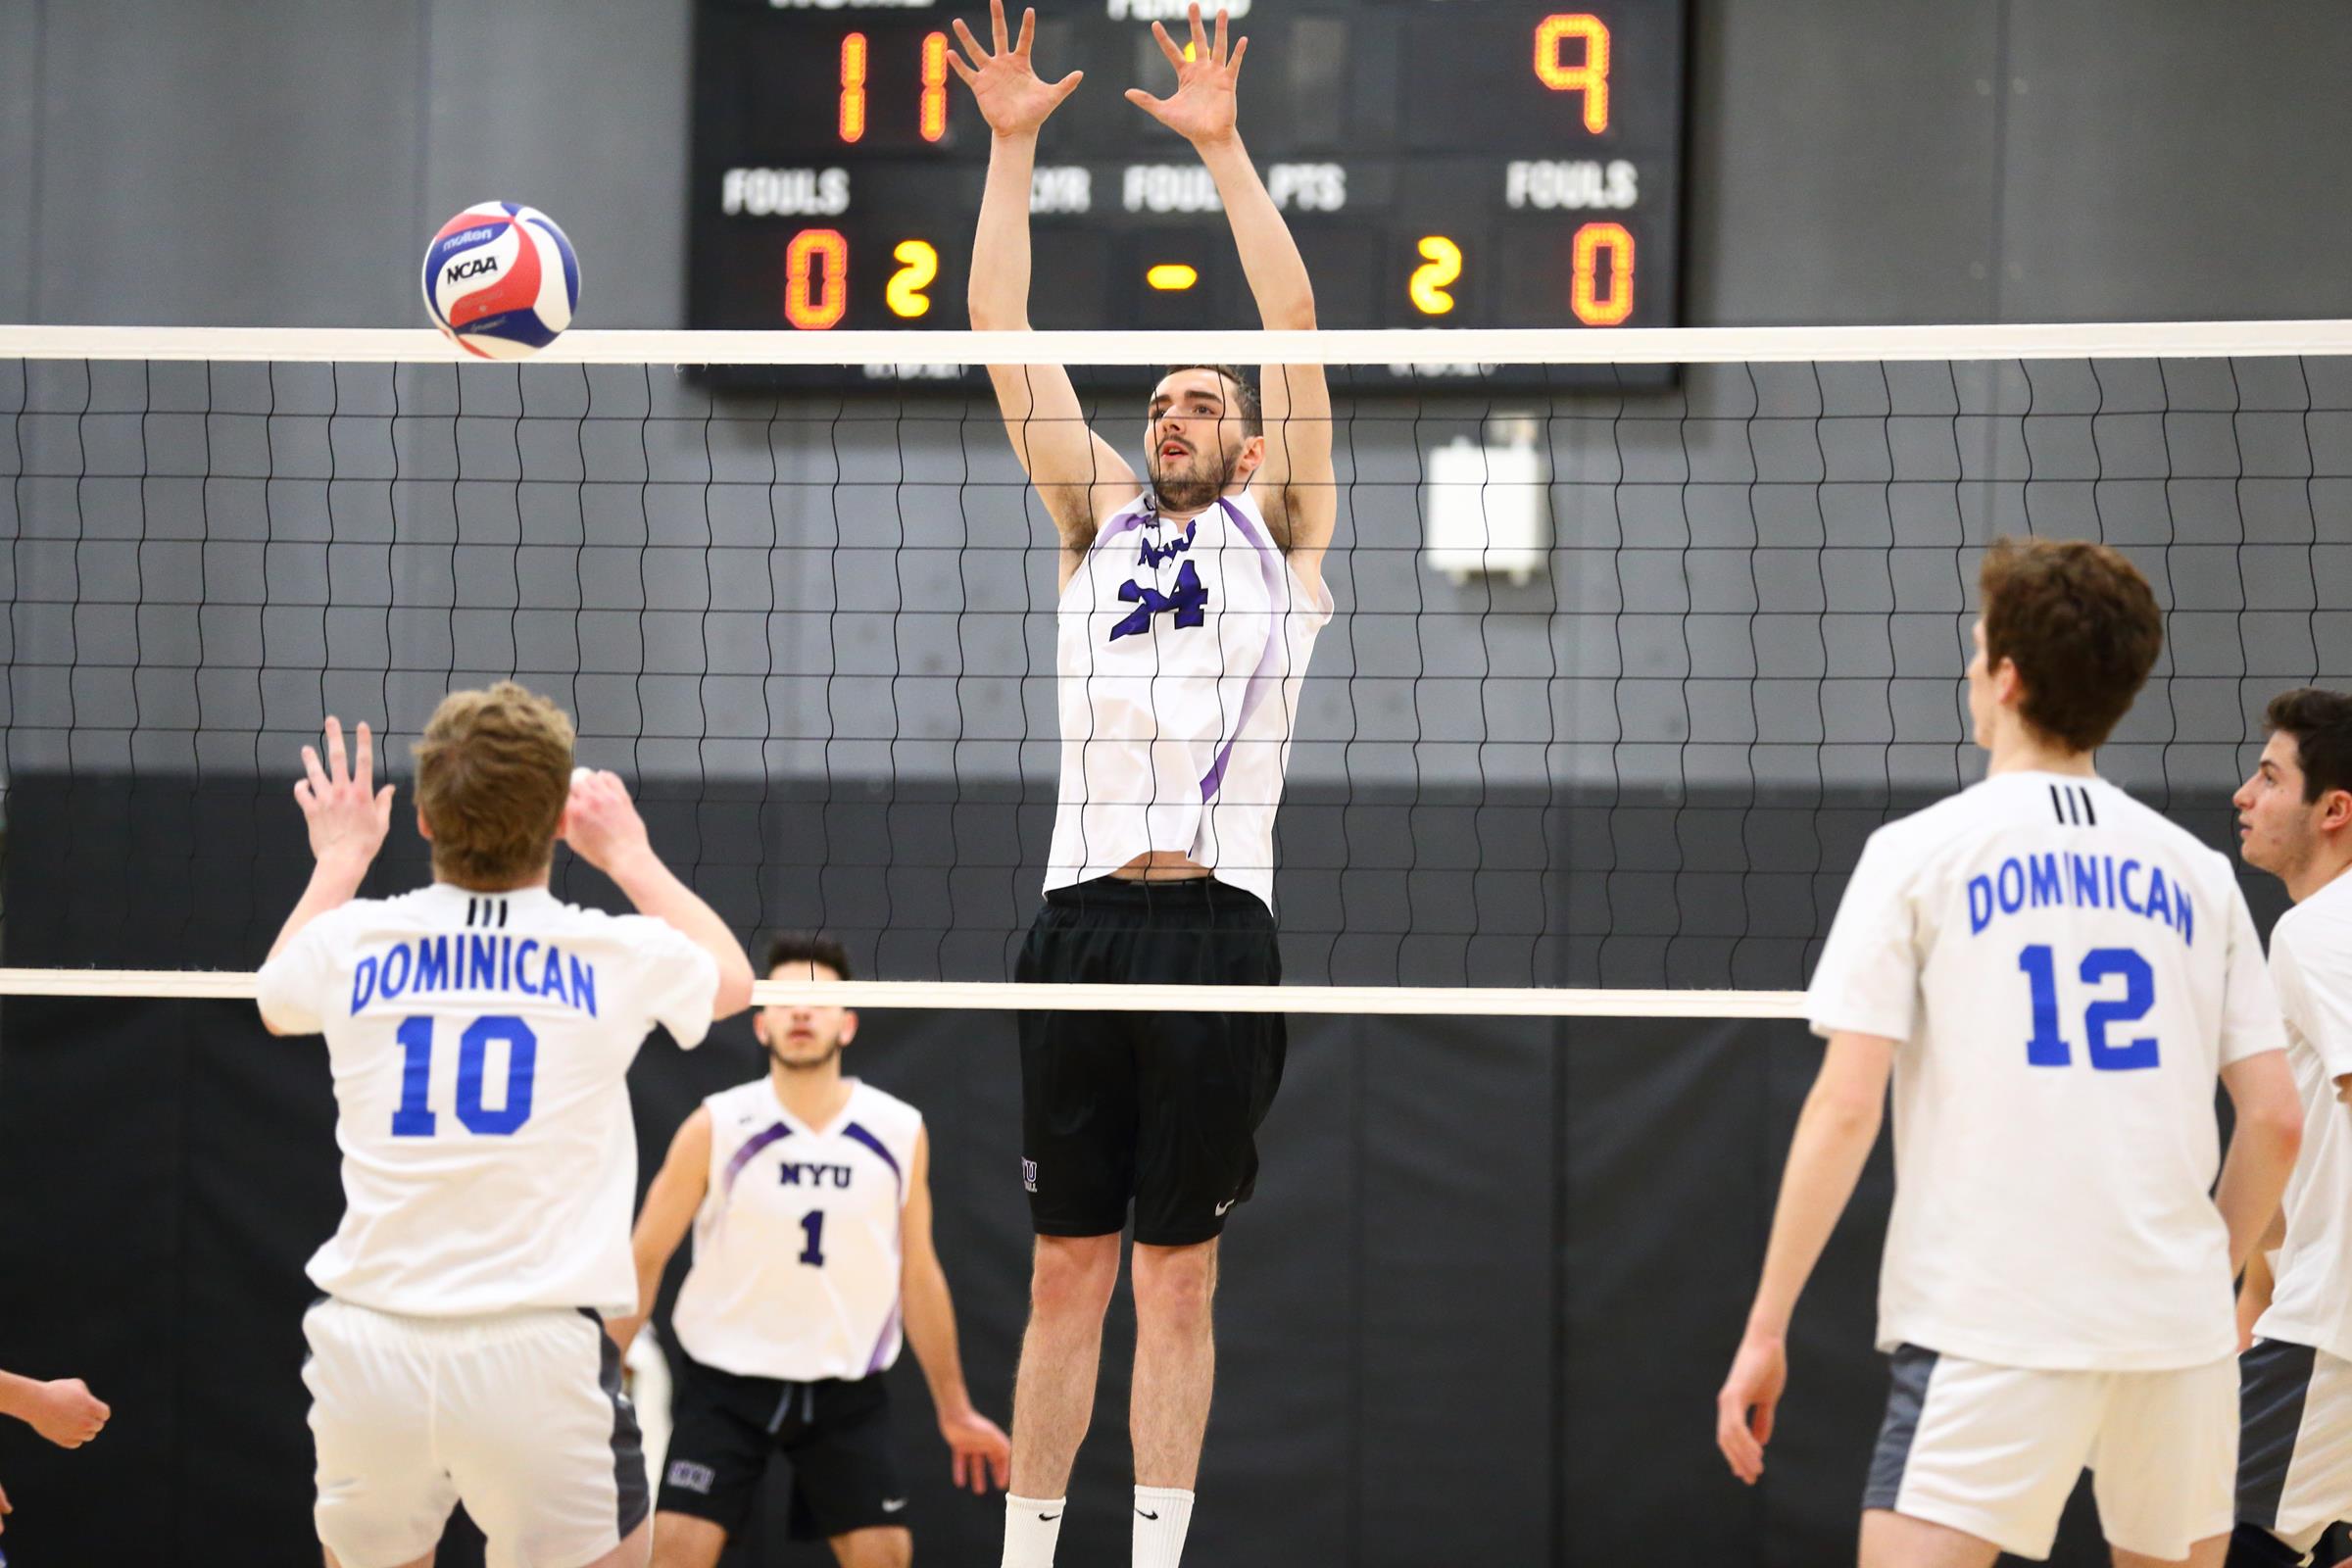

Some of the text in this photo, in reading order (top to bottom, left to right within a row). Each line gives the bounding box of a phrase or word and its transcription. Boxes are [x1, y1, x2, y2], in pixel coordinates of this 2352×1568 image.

[839, 31, 948, 142] 11
[1534, 13, 1610, 134] 9
[722, 168, 851, 216] FOULS
[1268, 163, 1348, 212] PTS
[1505, 159, 1639, 210] FOULS
[443, 227, 493, 252] molten
[447, 256, 498, 284] NCAA
[785, 228, 848, 330] 0
[886, 239, 939, 318] 2
[1408, 235, 1463, 315] 2
[1571, 221, 1636, 326] 0
[1108, 560, 1208, 642] 24
[350, 933, 597, 1017] DOMINICAN
[2018, 944, 2160, 1071] 12
[391, 1014, 538, 1138] 10
[780, 1162, 852, 1189] NYU
[799, 1209, 825, 1268] 1
